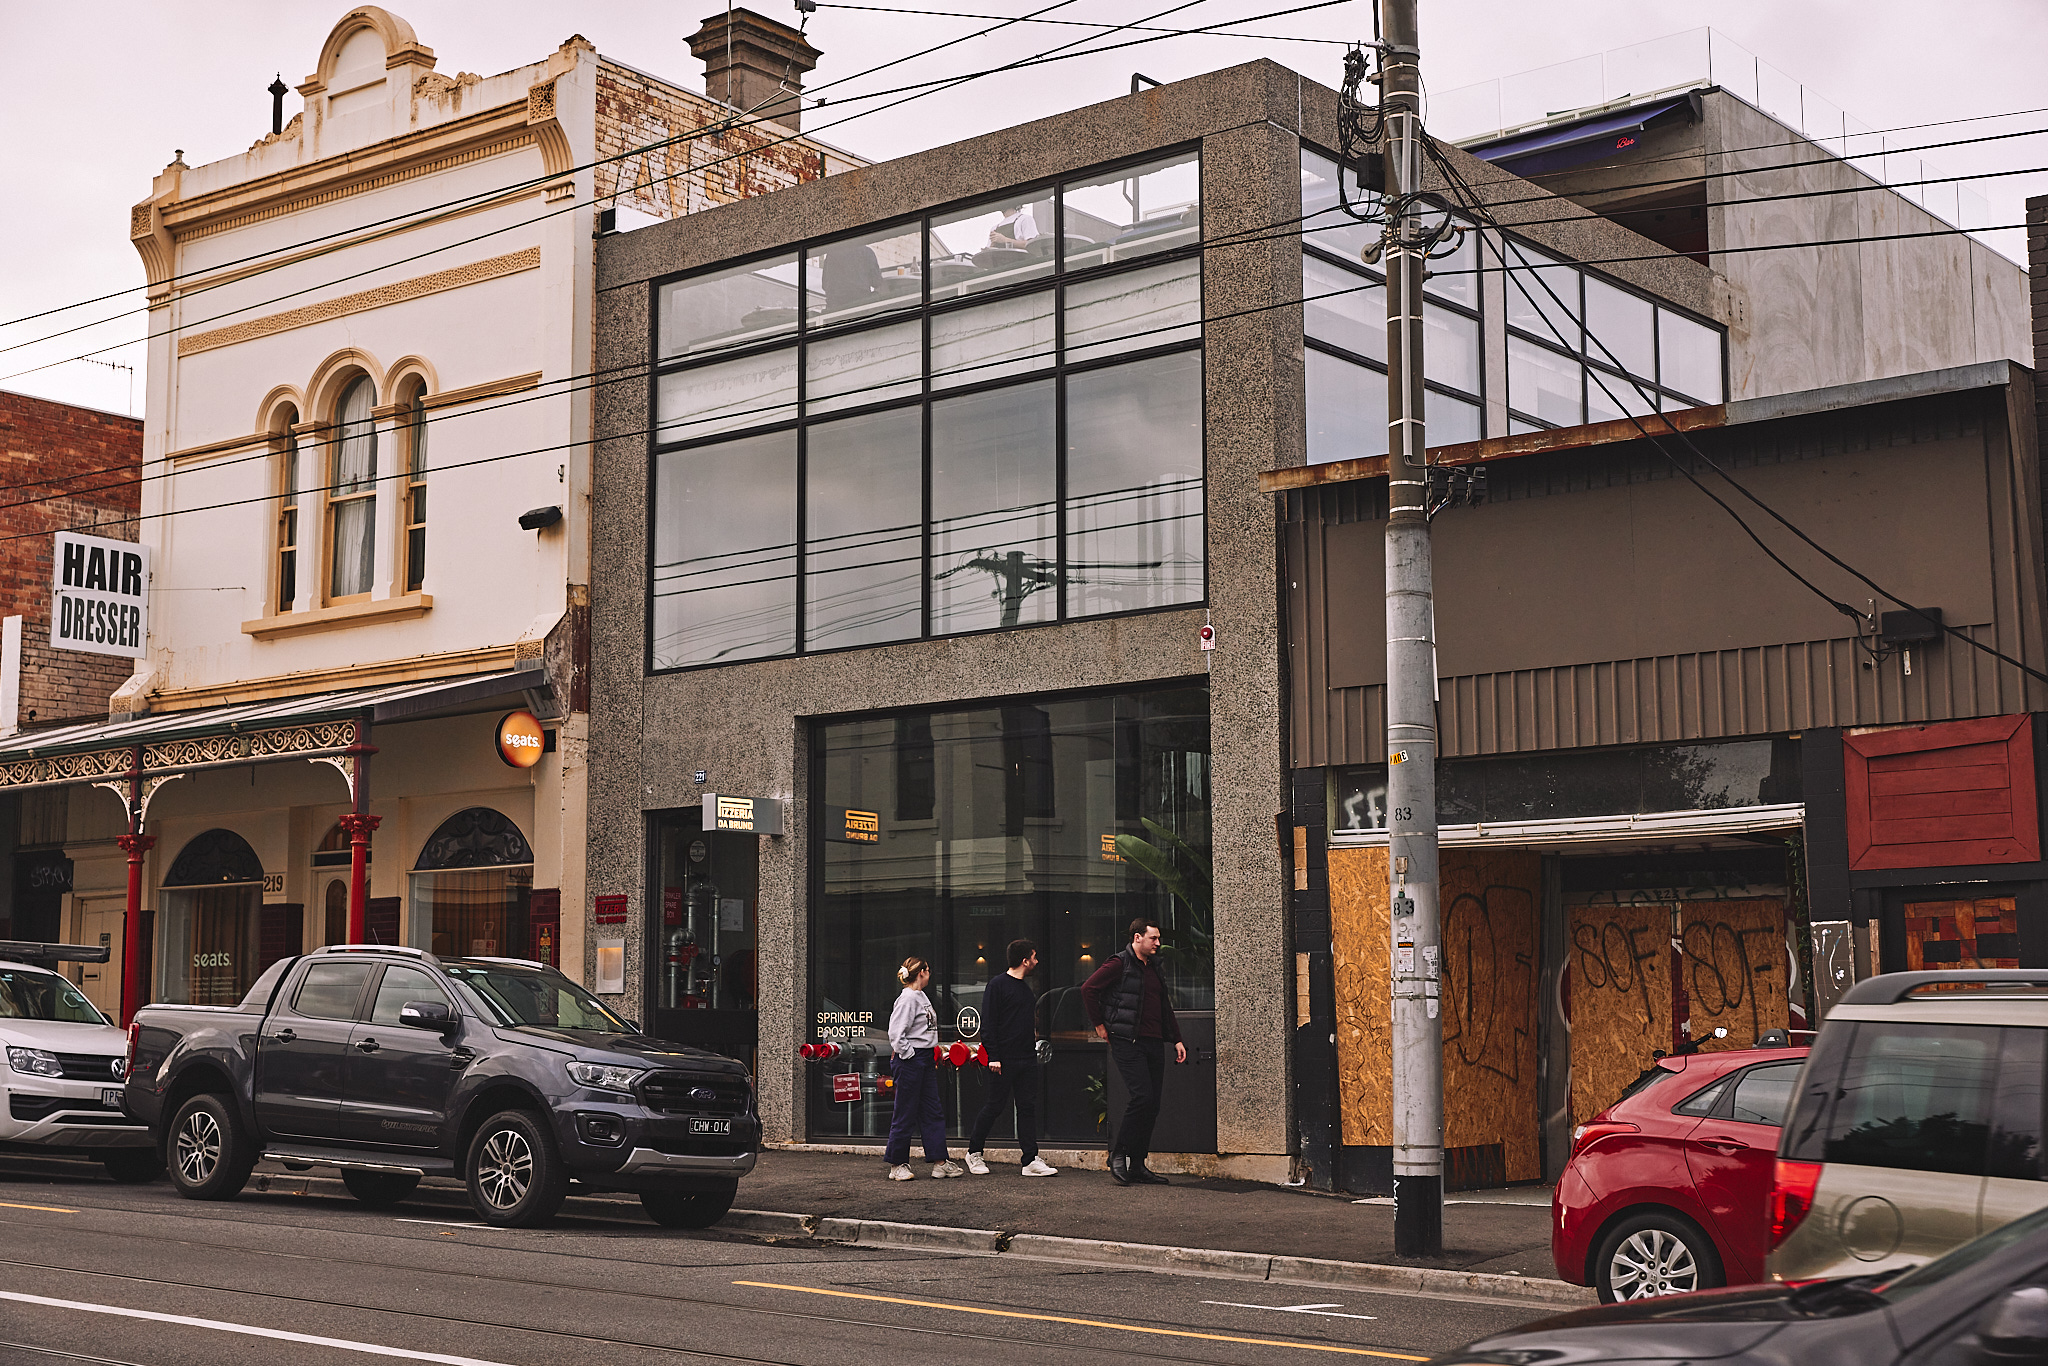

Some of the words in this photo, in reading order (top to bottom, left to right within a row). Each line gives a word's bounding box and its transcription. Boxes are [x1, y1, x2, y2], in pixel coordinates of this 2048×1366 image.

[1616, 137, 1635, 149] Bar
[62, 542, 142, 596] HAIR
[60, 596, 140, 647] DRESSER
[717, 797, 754, 820] PIZZERIA
[1395, 807, 1412, 821] 83
[718, 819, 728, 829] DA
[729, 820, 754, 830] BRUNO
[263, 875, 284, 892] 219
[595, 894, 628, 915] PIZZERIA
[1393, 900, 1415, 916] 83
[817, 1011, 873, 1024] SPRINKLER
[961, 1016, 976, 1028] FH
[817, 1025, 866, 1038] BOOSTER
